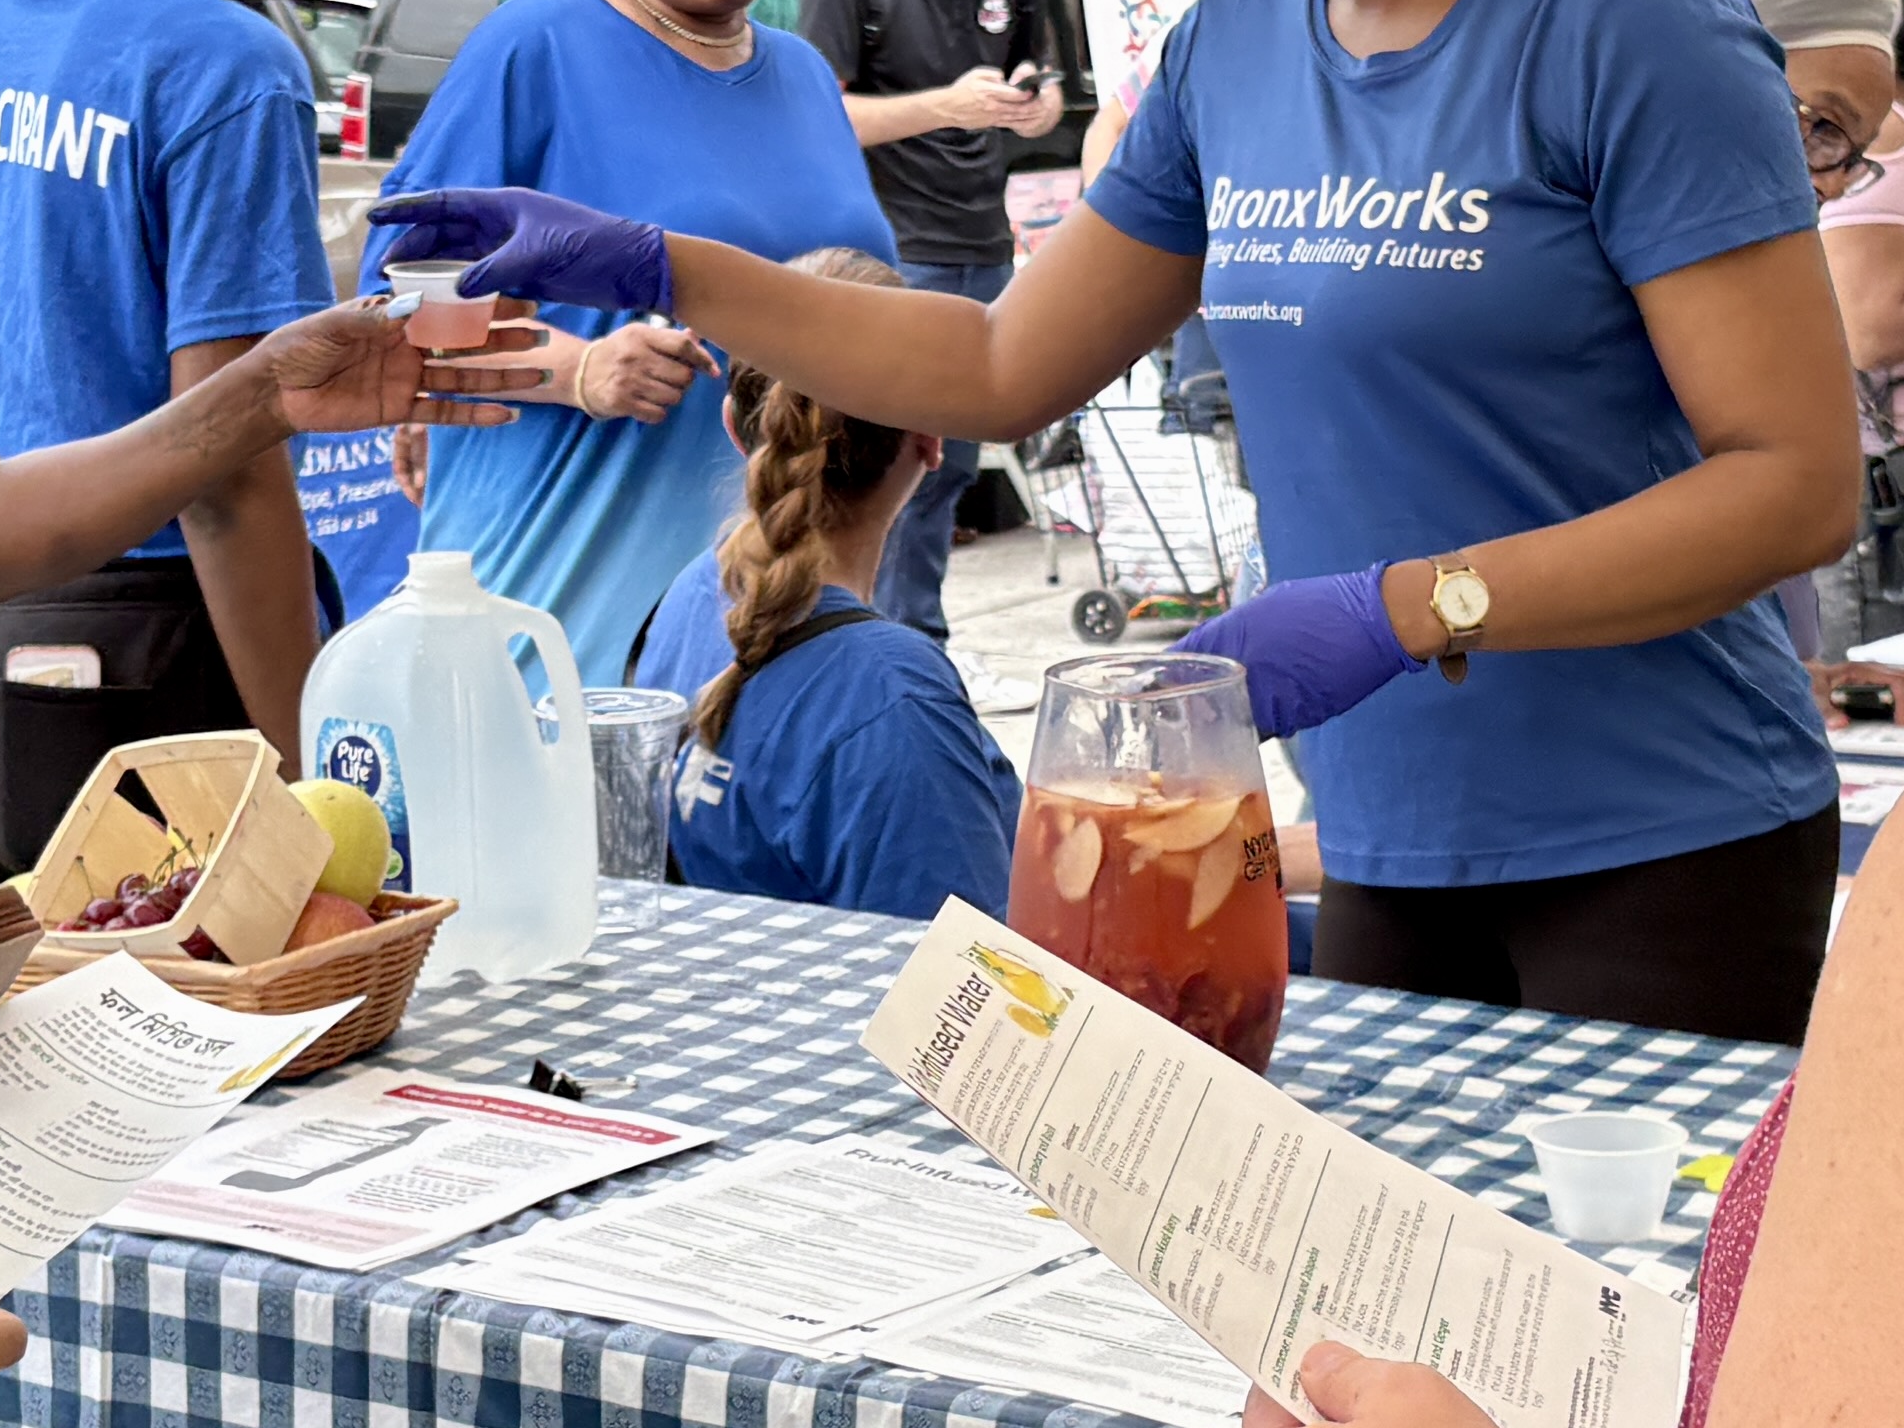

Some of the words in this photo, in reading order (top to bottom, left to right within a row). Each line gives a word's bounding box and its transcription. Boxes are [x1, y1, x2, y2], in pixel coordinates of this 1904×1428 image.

[1208, 171, 1490, 234] BronxWorks
[1234, 237, 1283, 266] Lives,
[1287, 236, 1369, 272] Building
[1374, 240, 1484, 272] Futures
[337, 740, 374, 764] Pure
[341, 759, 372, 784] Life
[939, 965, 995, 1031] Water
[843, 1147, 1011, 1192] Fruit-Infused
